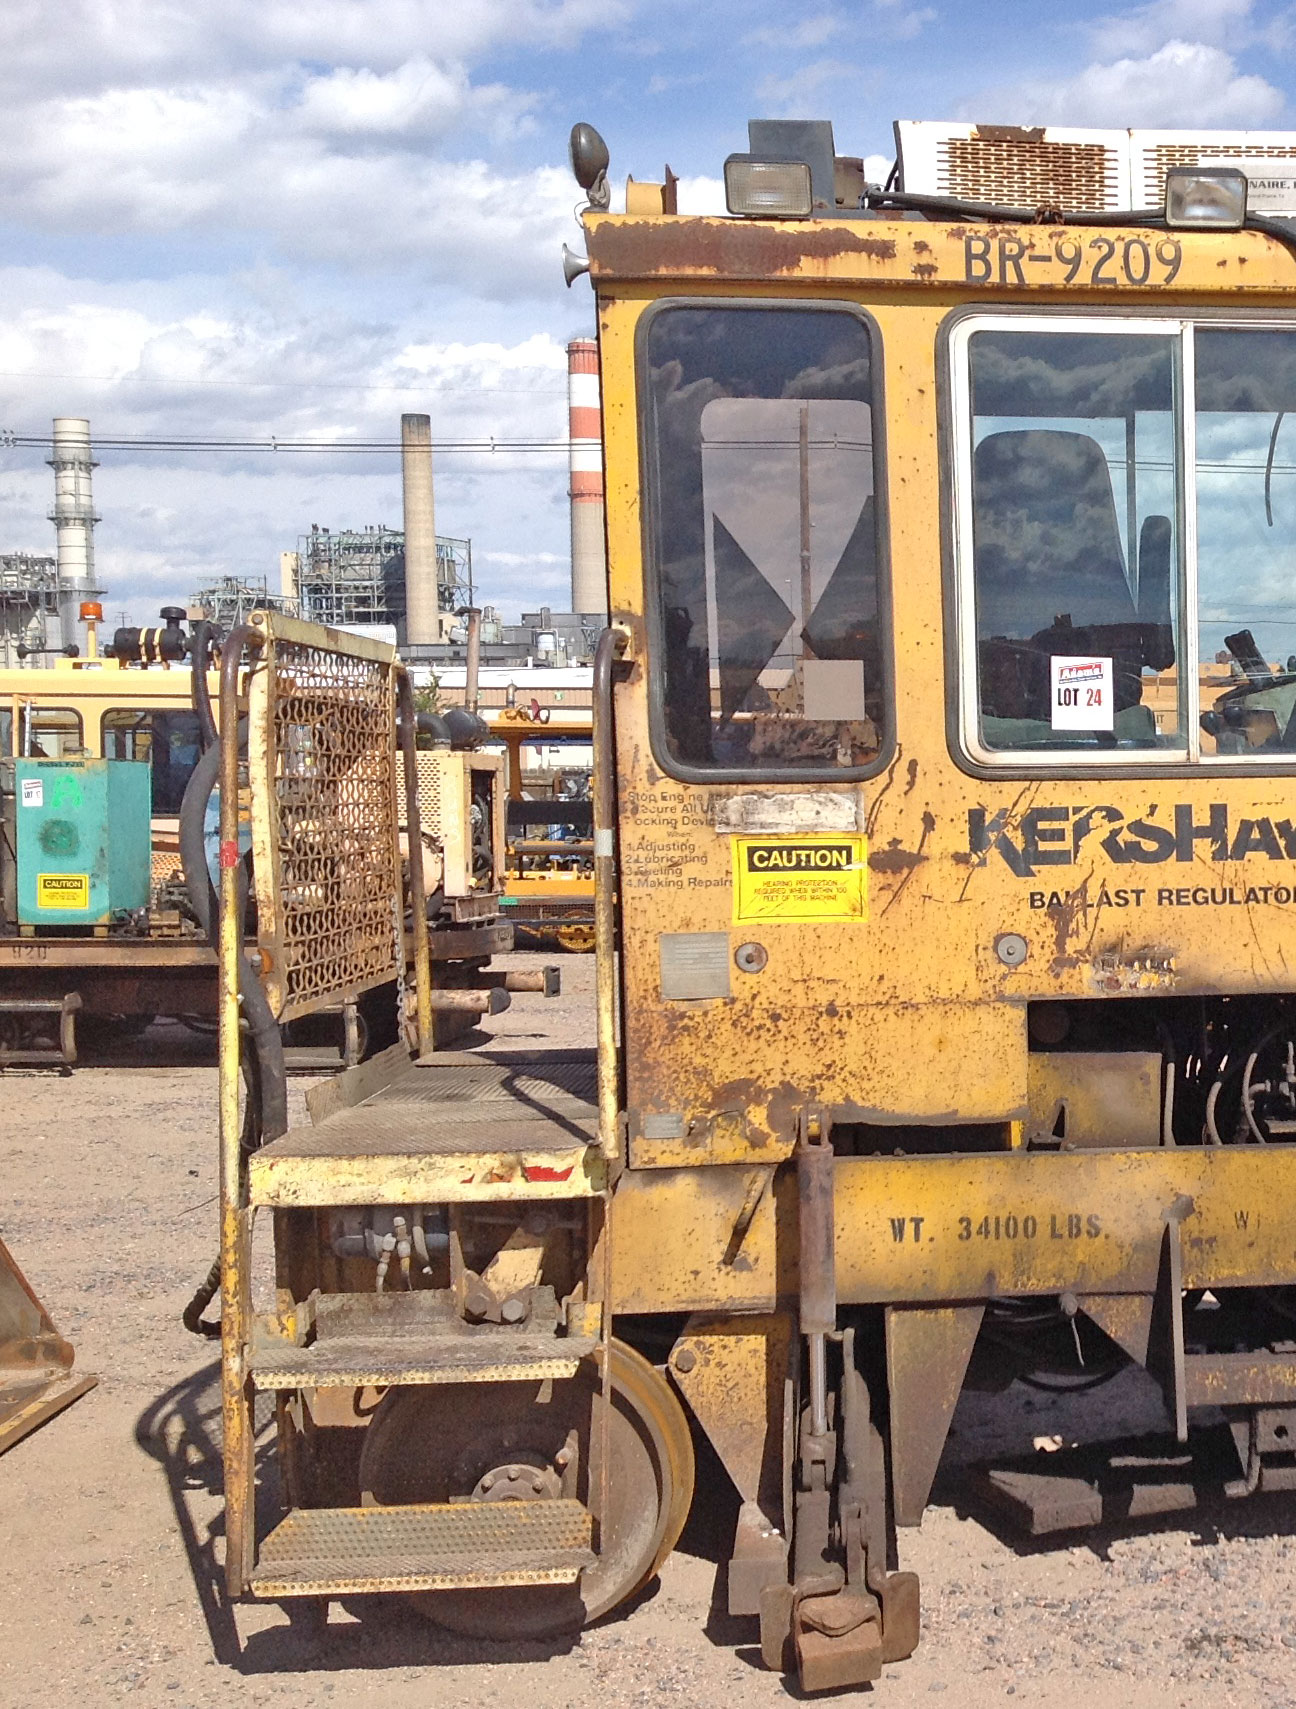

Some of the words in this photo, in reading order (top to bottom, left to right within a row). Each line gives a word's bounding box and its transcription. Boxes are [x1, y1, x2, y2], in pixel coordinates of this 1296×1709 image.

[965, 235, 1182, 285] BR-9209
[1057, 688, 1080, 706] LOT
[1086, 688, 1102, 706] 24
[628, 791, 657, 803] Stop
[660, 791, 703, 804] Engne
[640, 804, 677, 814] ecure
[681, 803, 697, 814] All
[634, 816, 679, 829] ocking
[753, 849, 847, 869] CAUTION
[45, 880, 81, 888] CAUTION
[888, 1216, 935, 1243] WT.
[957, 1214, 1037, 1241] 34100
